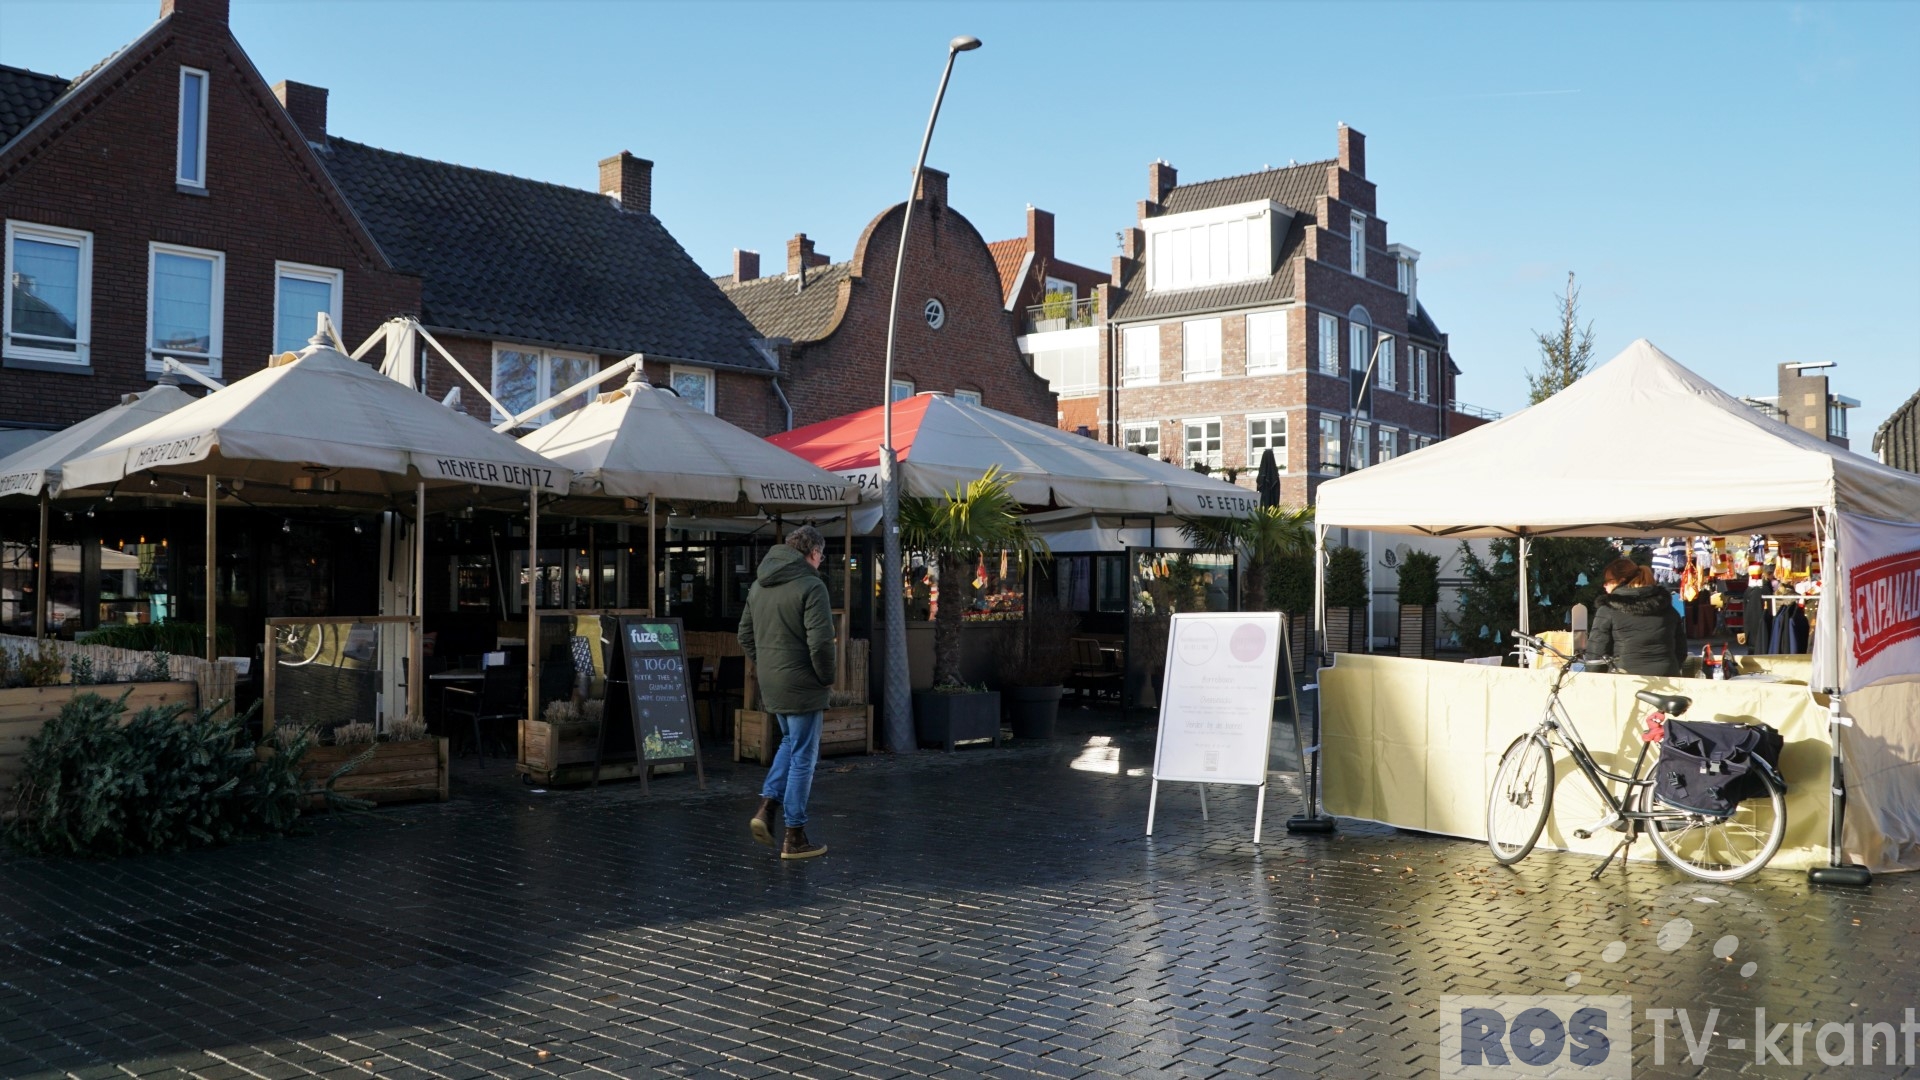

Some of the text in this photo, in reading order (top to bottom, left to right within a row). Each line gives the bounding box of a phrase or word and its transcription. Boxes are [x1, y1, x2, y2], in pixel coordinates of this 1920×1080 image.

[134, 435, 200, 467] MENEER DENTZ
[437, 459, 554, 488] MENEER DENTZ
[760, 483, 846, 501] MENEER DENTZ
[1197, 495, 1214, 509] DE
